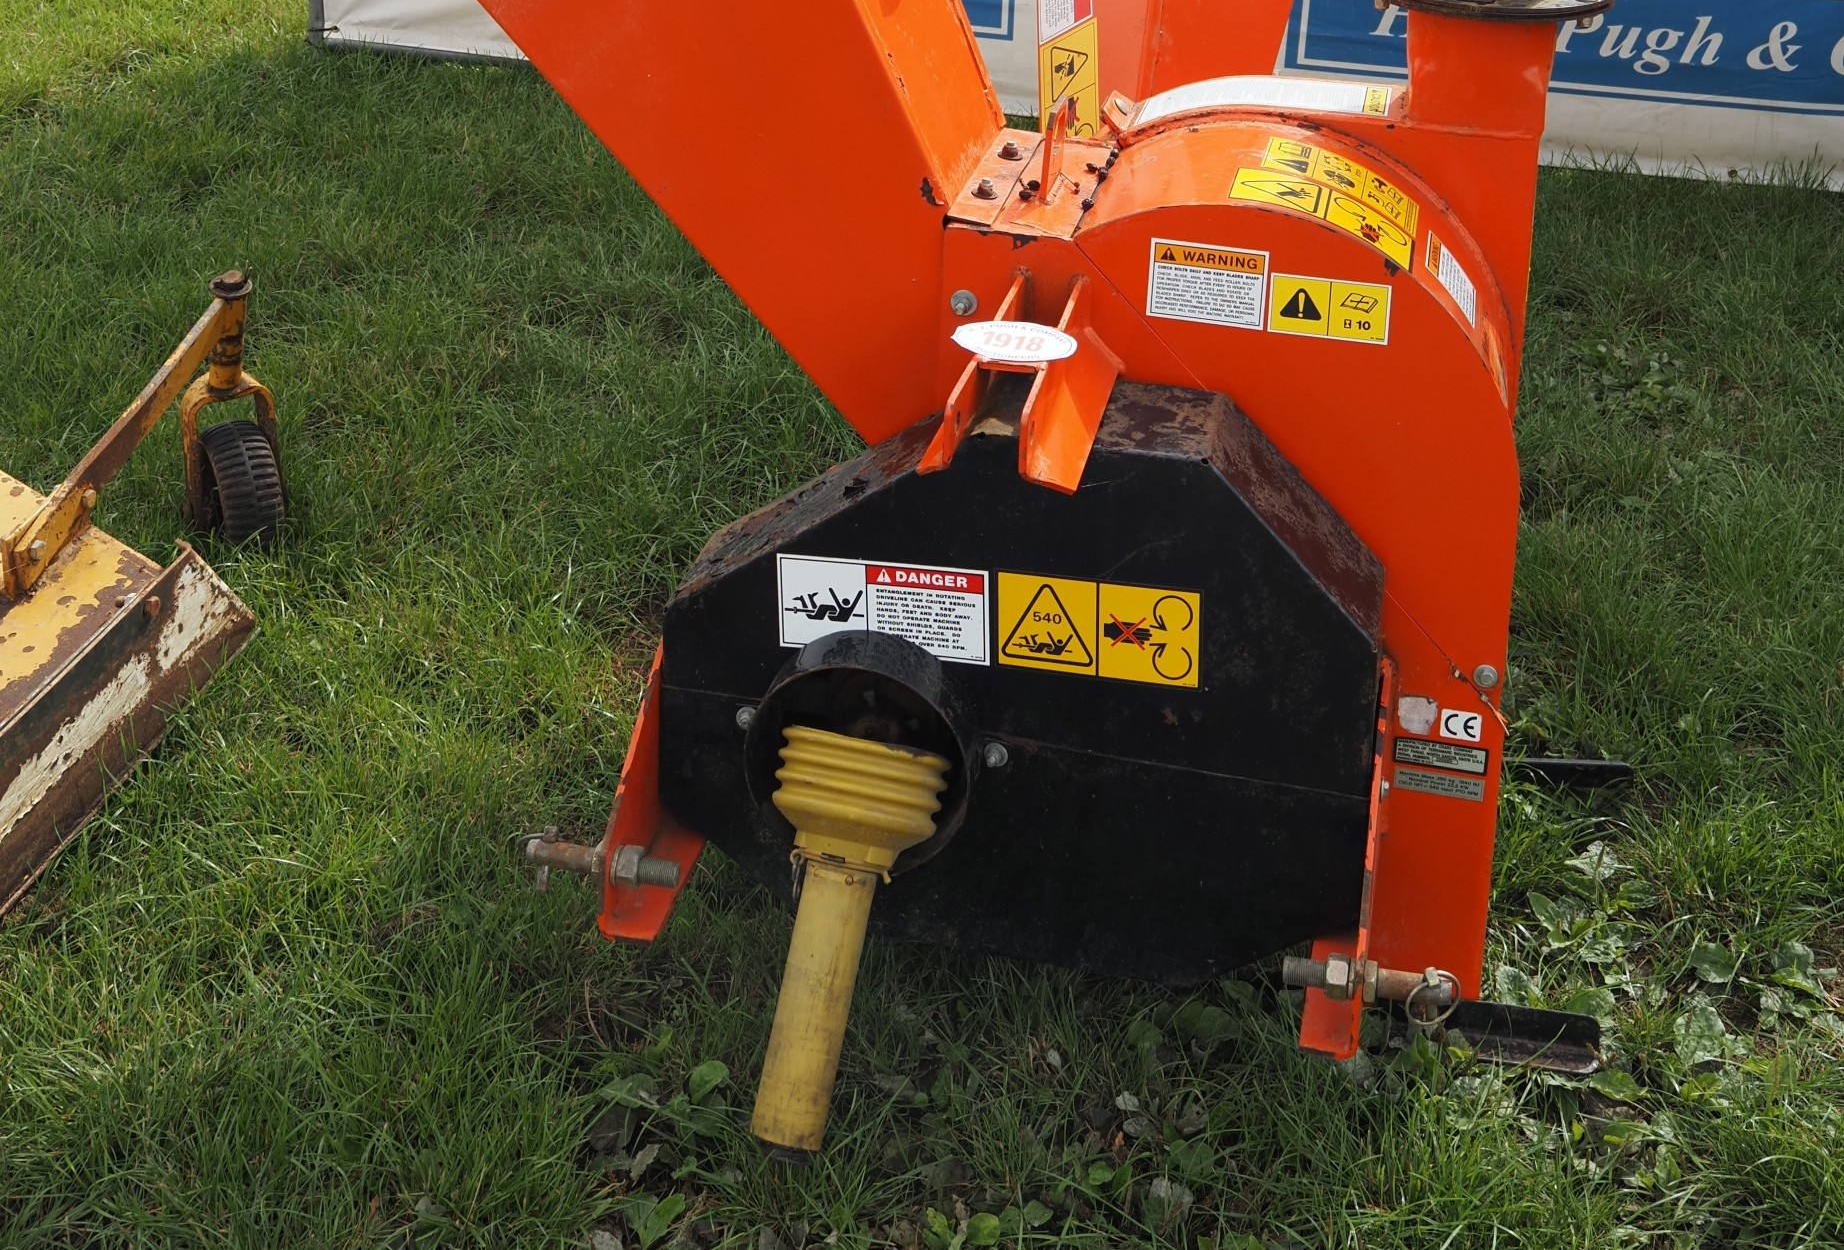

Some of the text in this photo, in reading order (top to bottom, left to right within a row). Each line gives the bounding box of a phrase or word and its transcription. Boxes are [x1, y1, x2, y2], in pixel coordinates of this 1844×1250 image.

[1746, 21, 1802, 72] &
[1182, 251, 1258, 269] WARNING
[1356, 320, 1371, 330] 10
[983, 330, 1046, 352] 1918
[896, 571, 967, 588] DANGER
[876, 588, 924, 596] ENTANGLEMENT
[1032, 610, 1062, 626] 540
[1444, 714, 1477, 738] CE
